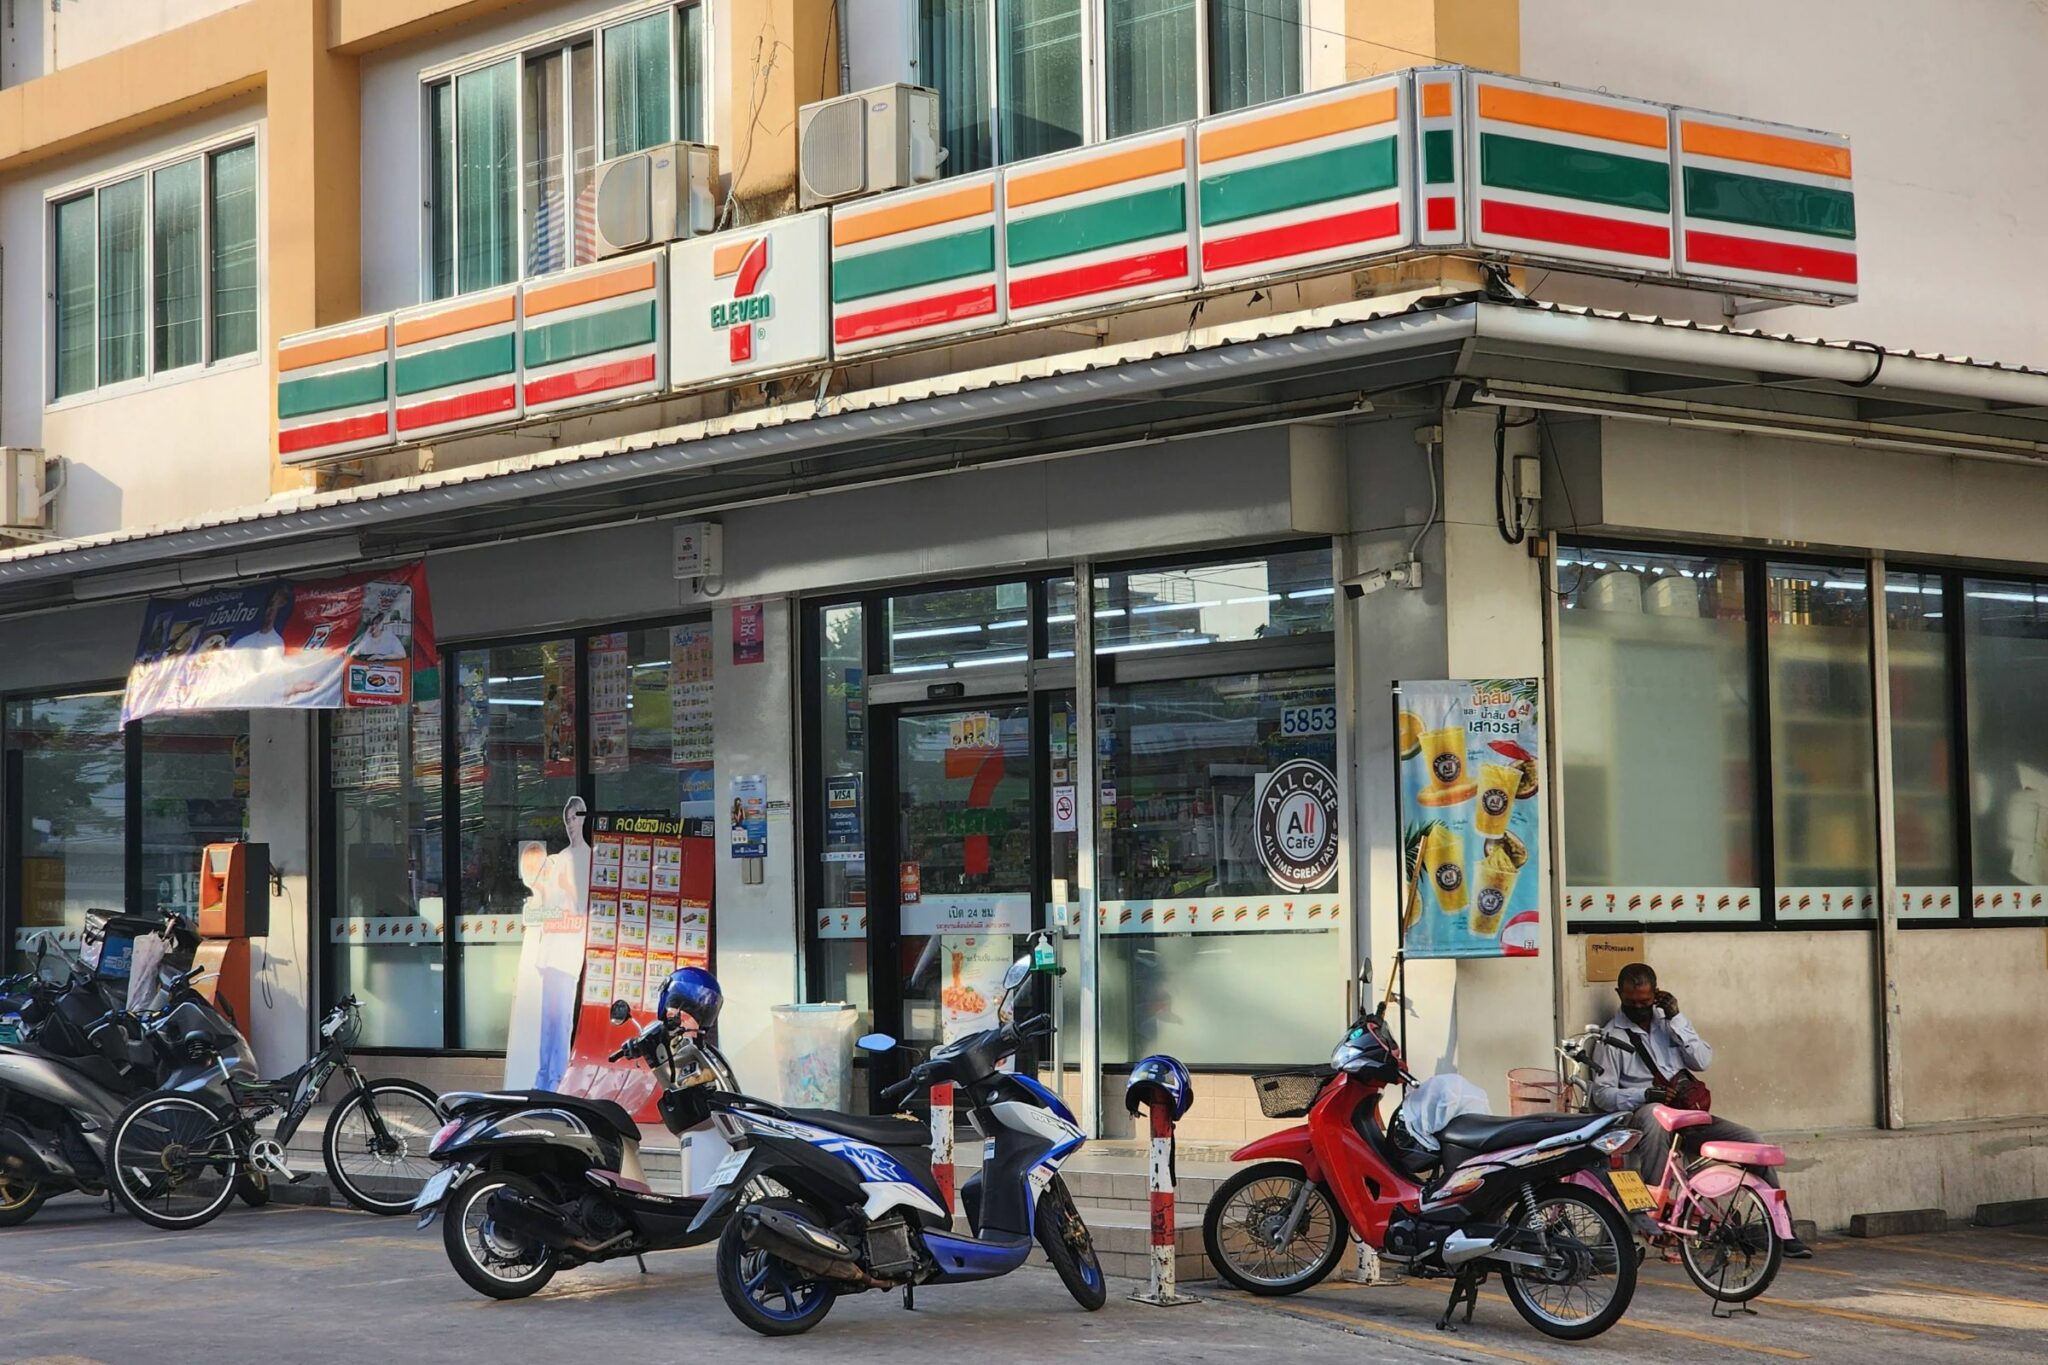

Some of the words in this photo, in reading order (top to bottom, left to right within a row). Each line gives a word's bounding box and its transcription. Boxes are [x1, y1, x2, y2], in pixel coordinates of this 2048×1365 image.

[713, 237, 768, 362] 7
[1472, 686, 1512, 707] น้ำส้ม
[1284, 706, 1337, 734] 5853
[834, 790, 851, 800] VISA
[1267, 774, 1298, 814] ALL
[1286, 803, 1316, 834] All
[1264, 835, 1276, 857] ALL
[1272, 853, 1293, 876] TIME
[1292, 864, 1321, 879] GREAT
[1319, 833, 1338, 866] TASTE
[949, 905, 964, 919] เปิด
[967, 908, 978, 917] 24
[291, 1064, 333, 1118] TIGER
